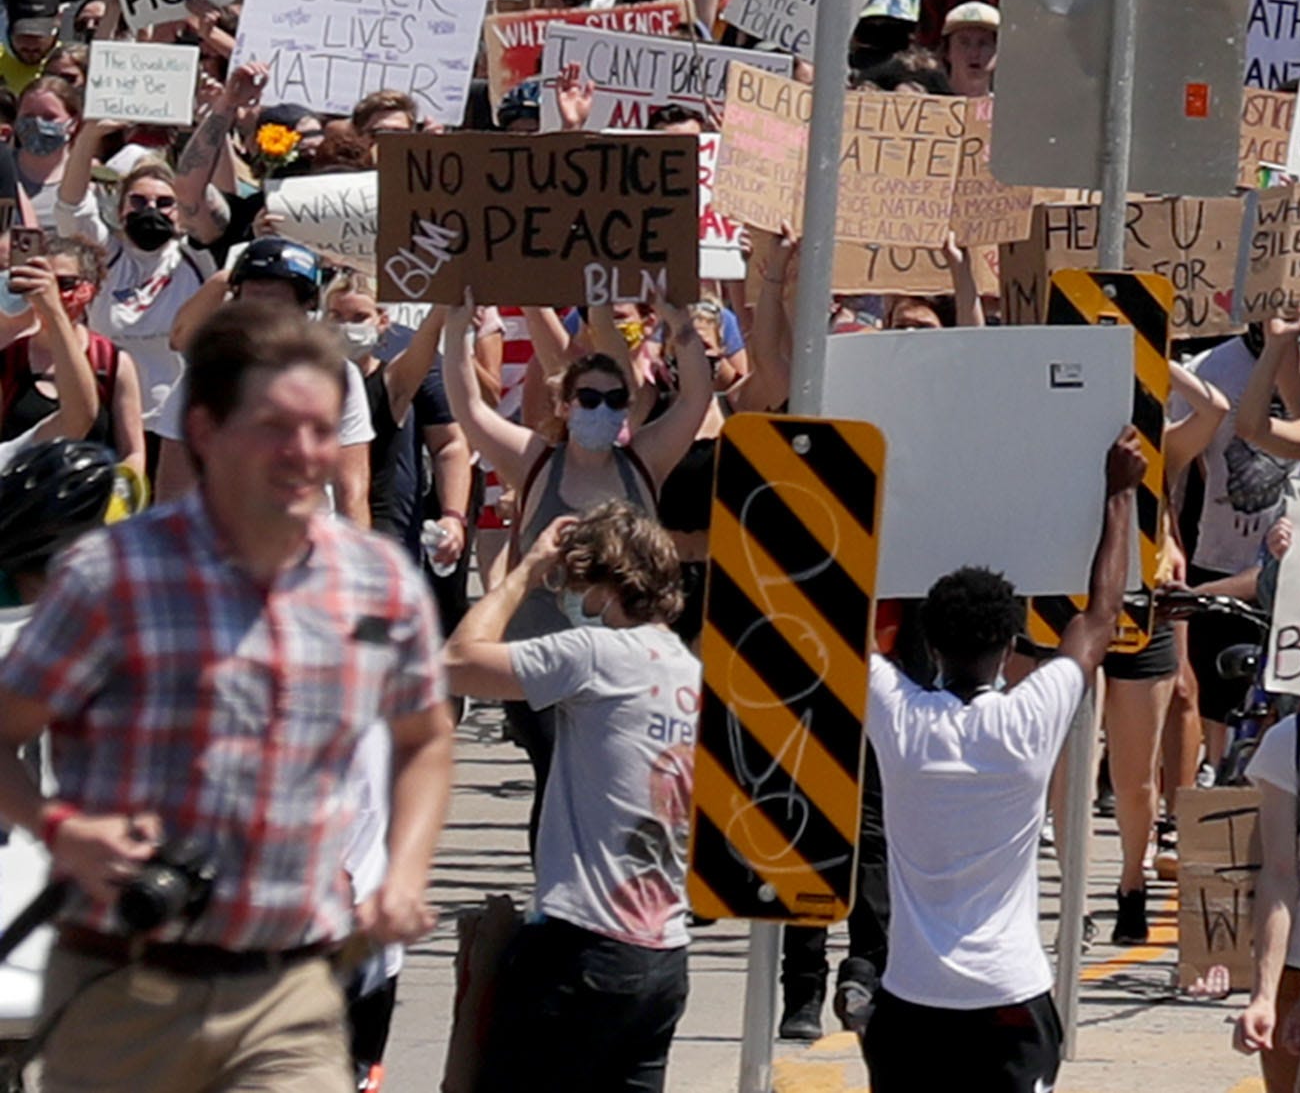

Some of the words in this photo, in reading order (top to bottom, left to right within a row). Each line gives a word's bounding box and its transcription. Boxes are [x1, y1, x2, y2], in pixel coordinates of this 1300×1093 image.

[322, 13, 416, 52] LIVES
[585, 9, 674, 38] SILENCE
[550, 34, 578, 68] I
[586, 38, 661, 86] CANT
[853, 97, 966, 139] LIVES
[406, 148, 465, 194] NO
[486, 144, 692, 198] JUSTICE
[484, 206, 670, 262] PEACE
[384, 218, 463, 301] BLM
[1154, 260, 1210, 290] FOR
[584, 263, 669, 305] BLM
